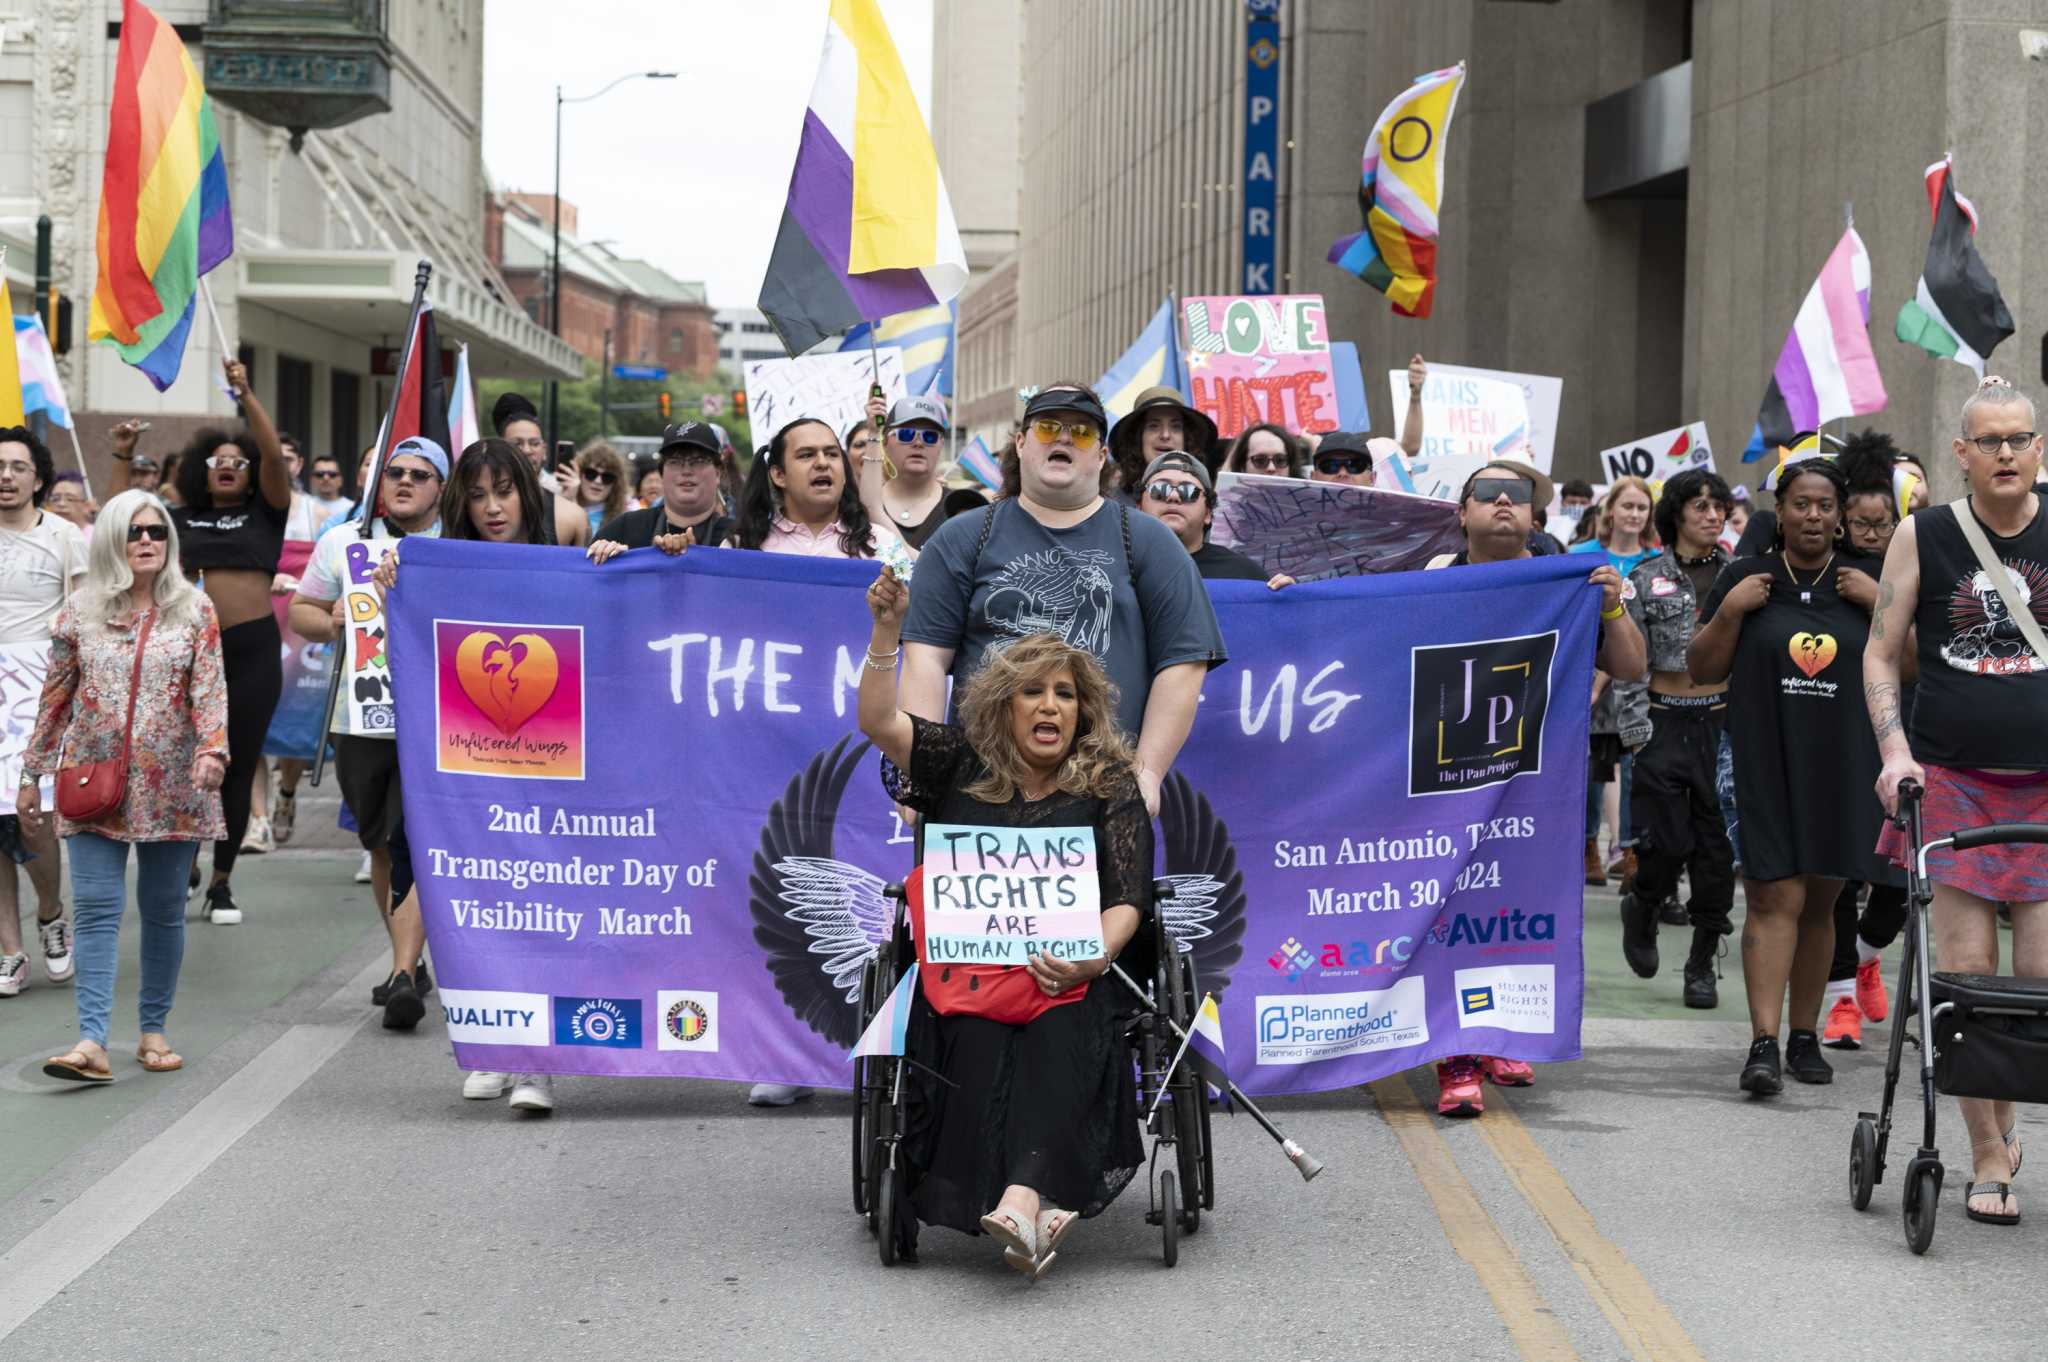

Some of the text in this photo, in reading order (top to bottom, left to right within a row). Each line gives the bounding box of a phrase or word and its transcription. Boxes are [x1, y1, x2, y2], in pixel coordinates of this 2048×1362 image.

[1247, 96, 1273, 292] PARK
[1186, 299, 1332, 354] LOVE
[1191, 371, 1337, 438] HATE
[1448, 407, 1497, 436] MEN
[1607, 447, 1654, 481] NO
[997, 548, 1062, 583] HINANO
[647, 633, 803, 717] THE
[1660, 694, 1721, 707] UNDERWEAR
[449, 732, 521, 757] Unfiltered
[525, 737, 568, 761] Wings
[1438, 759, 1520, 783] The J Pan Project
[488, 804, 656, 837] 2nd Annual
[943, 831, 1085, 873] TRANS
[1274, 840, 1327, 868] San
[1335, 829, 1458, 864] Antonio,
[428, 848, 718, 894] Transgender Day of
[932, 873, 1077, 910] RIGHTS
[1307, 882, 1402, 916] March
[1409, 879, 1447, 909] 30,
[450, 899, 693, 941] Visibility March
[985, 913, 1038, 936] ARE
[1447, 908, 1556, 947] Avita
[928, 936, 1012, 961] HUMAN
[1319, 935, 1413, 968] aarc
[1498, 982, 1549, 993] HUMAN
[1500, 994, 1549, 1006] RIGHTS
[1291, 1002, 1369, 1022] Planned
[1291, 1011, 1393, 1043] Parenthood
[1260, 1031, 1421, 1058] Planned Parenthood South Texas
